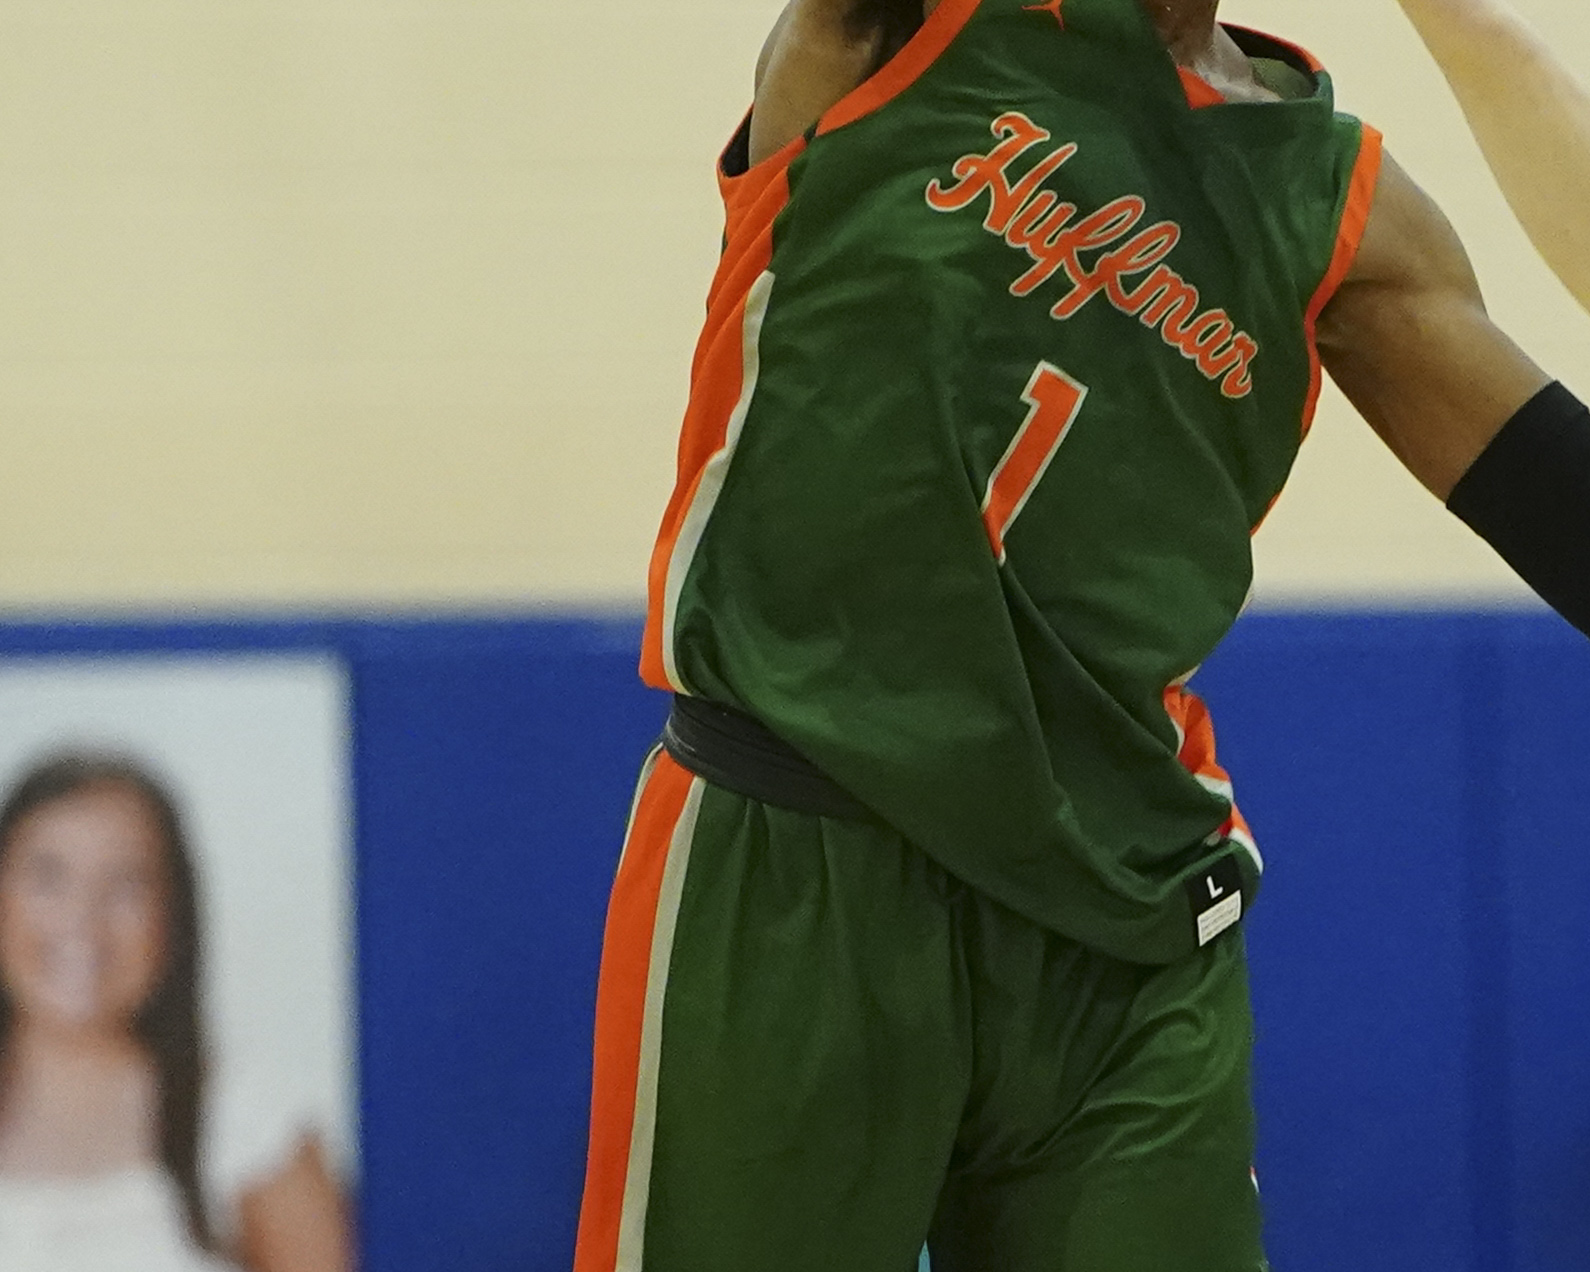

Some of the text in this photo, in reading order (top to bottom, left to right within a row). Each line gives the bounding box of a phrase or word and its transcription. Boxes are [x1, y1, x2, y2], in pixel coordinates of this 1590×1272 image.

[925, 111, 1259, 398] Huffman
[980, 359, 1089, 566] 1
[1206, 875, 1224, 899] L
